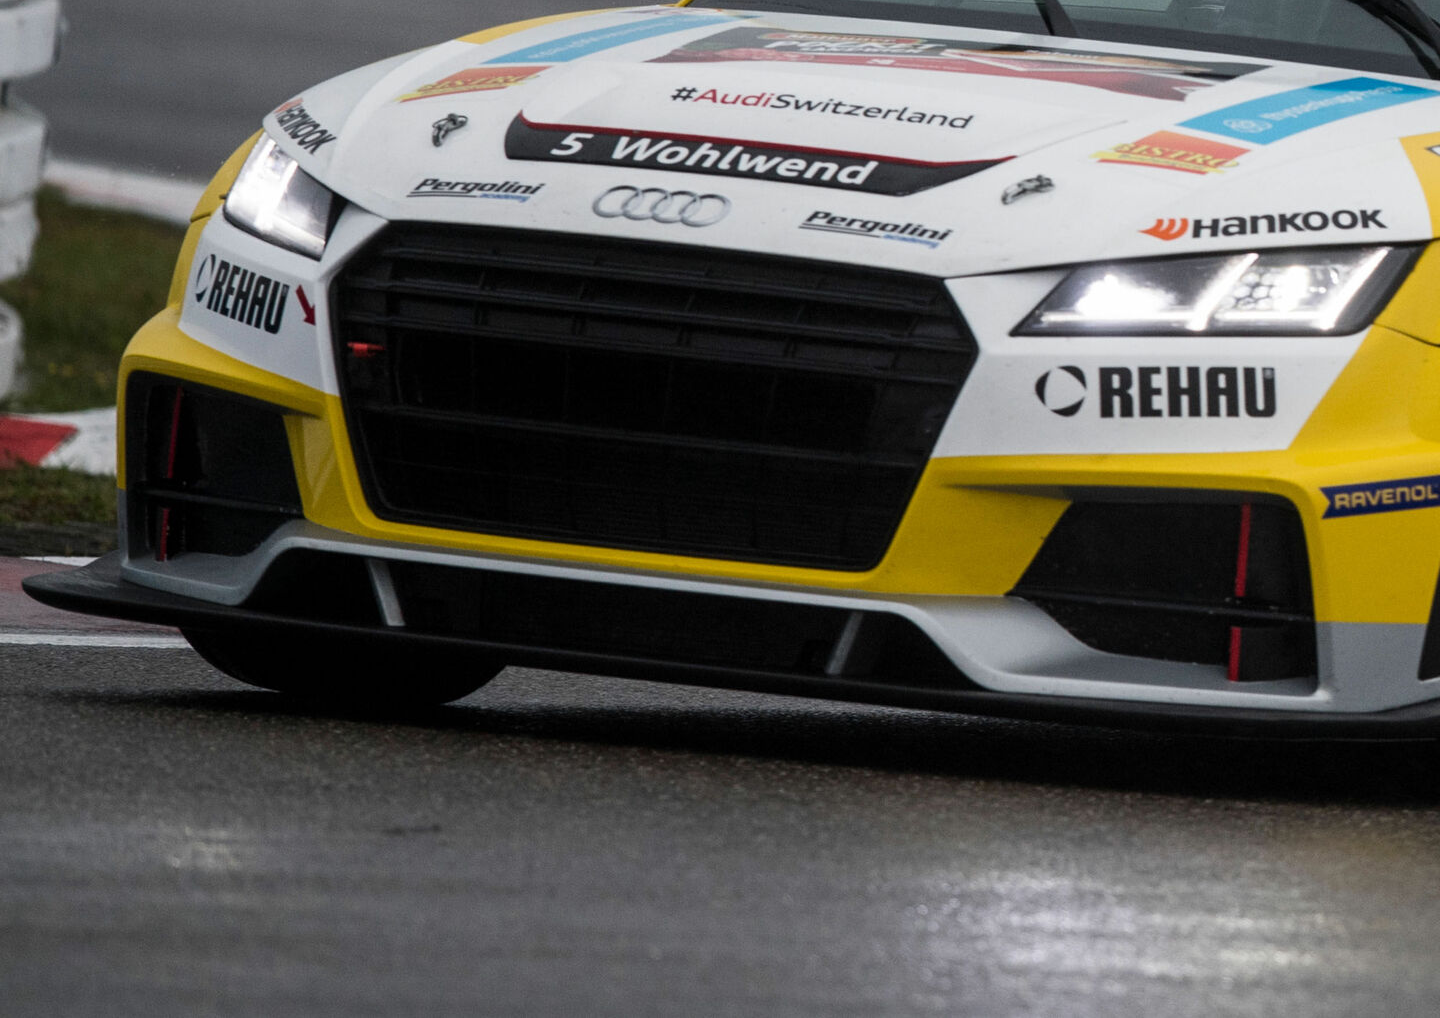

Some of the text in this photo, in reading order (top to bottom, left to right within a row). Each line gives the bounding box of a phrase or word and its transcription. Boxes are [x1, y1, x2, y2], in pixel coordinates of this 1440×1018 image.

[671, 86, 974, 130] #AudiSwitzerland
[550, 132, 879, 186] 5 Wohlwend
[413, 178, 546, 195] Pergolini
[805, 211, 954, 241] Pergolini
[207, 259, 290, 335] REHAU
[1100, 366, 1277, 418] REHAU
[1334, 485, 1439, 509] RAVENOL
